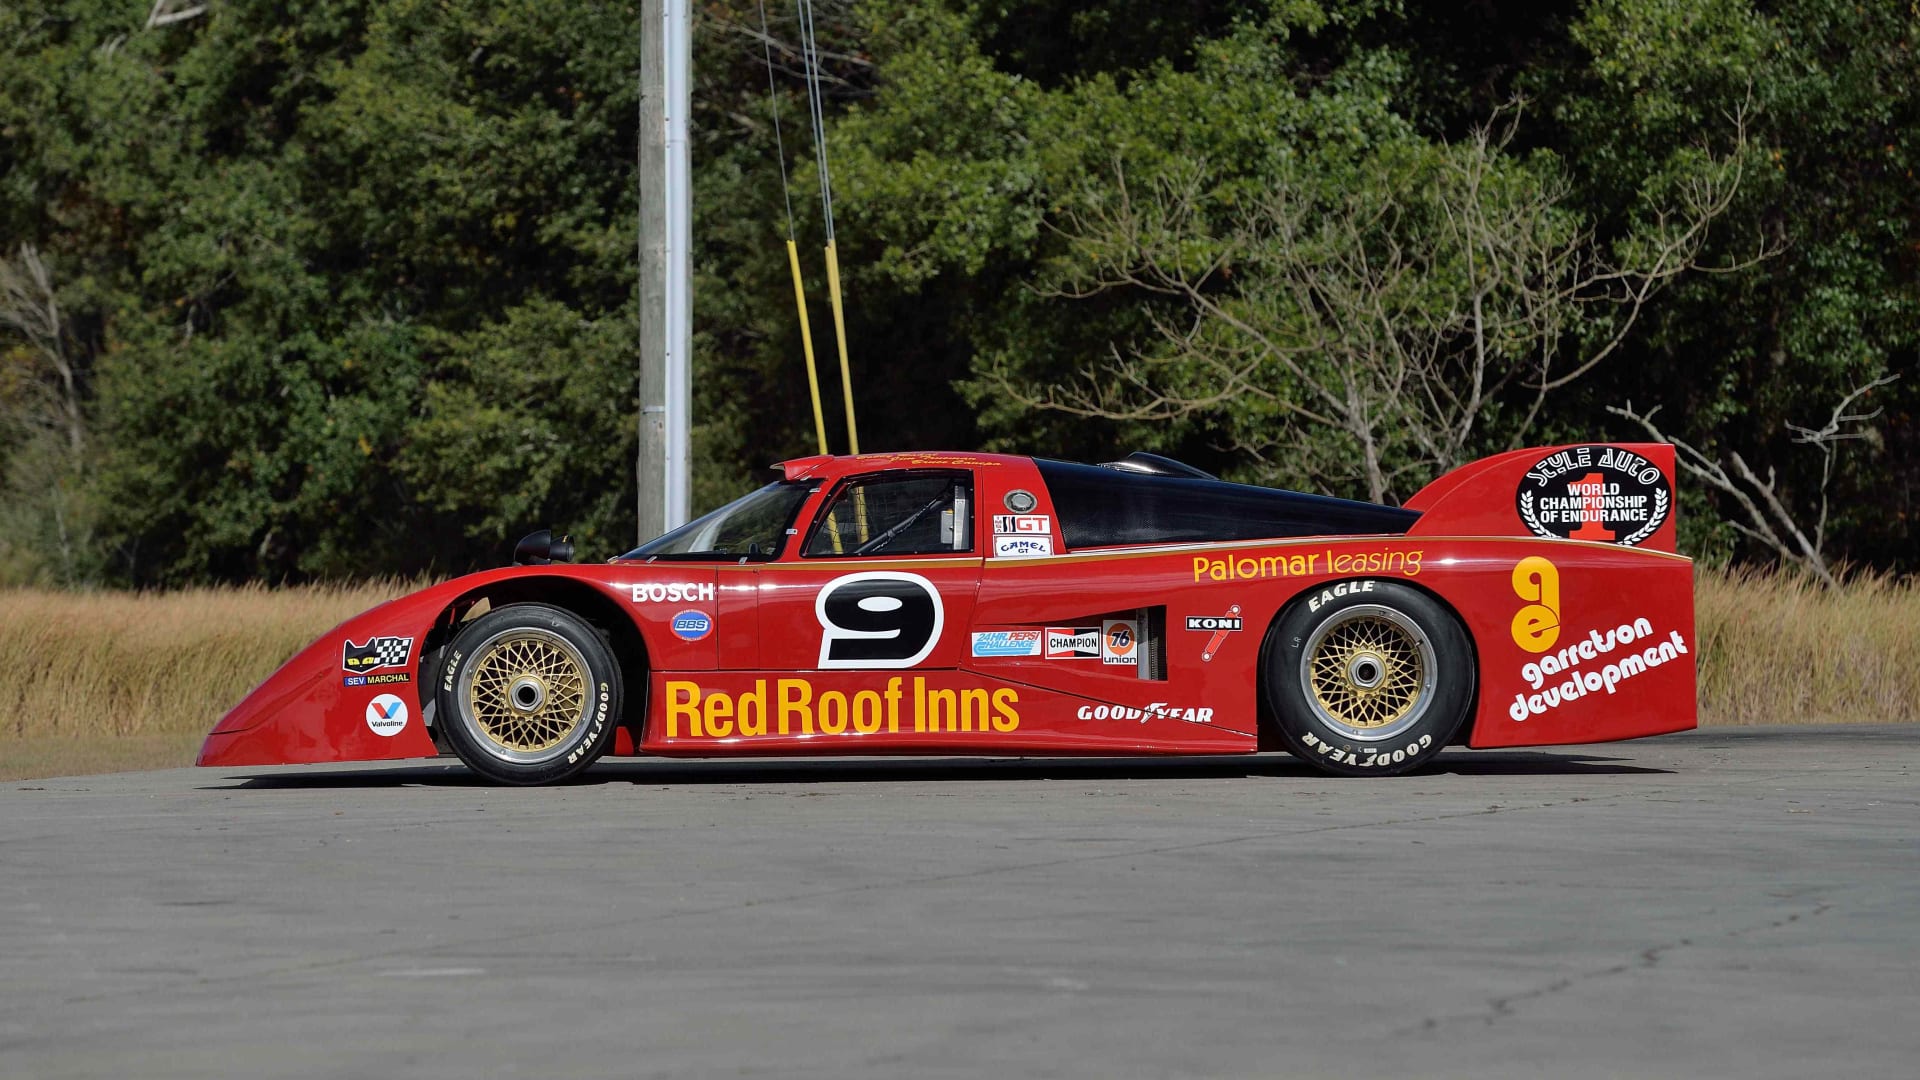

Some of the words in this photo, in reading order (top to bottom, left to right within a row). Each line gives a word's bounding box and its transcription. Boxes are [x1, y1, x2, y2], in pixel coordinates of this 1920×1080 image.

[1567, 483, 1620, 496] WORLD
[1540, 495, 1648, 510] CHAMPIONSHIP
[1540, 511, 1558, 523] OF
[1561, 508, 1648, 523] ENDURANCE
[1016, 517, 1048, 532] GT
[1000, 541, 1046, 552] CAMEL
[1193, 553, 1320, 583] Palomar
[1326, 547, 1424, 577] leasing
[632, 582, 714, 603] BOSCH
[1308, 580, 1375, 613] EAGLE
[674, 619, 709, 632] BBS
[814, 571, 945, 670] 9
[1188, 618, 1240, 630] KONI
[1050, 637, 1097, 649] CHAMPION
[1110, 630, 1130, 646] 76
[1104, 656, 1137, 664] union
[1521, 617, 1654, 690] garretson
[443, 650, 462, 692] EAGLE
[1509, 630, 1689, 722] development
[347, 677, 365, 686] SEV
[367, 674, 409, 684] MARCHAL
[665, 679, 768, 738] Red
[777, 677, 902, 736] Roof
[914, 677, 1020, 734] Inns
[1077, 702, 1214, 724] GOODYEAR
[371, 720, 404, 728] Valvoline
[566, 682, 609, 764] GOODYEAR
[1302, 731, 1432, 767] GOODYEAR
